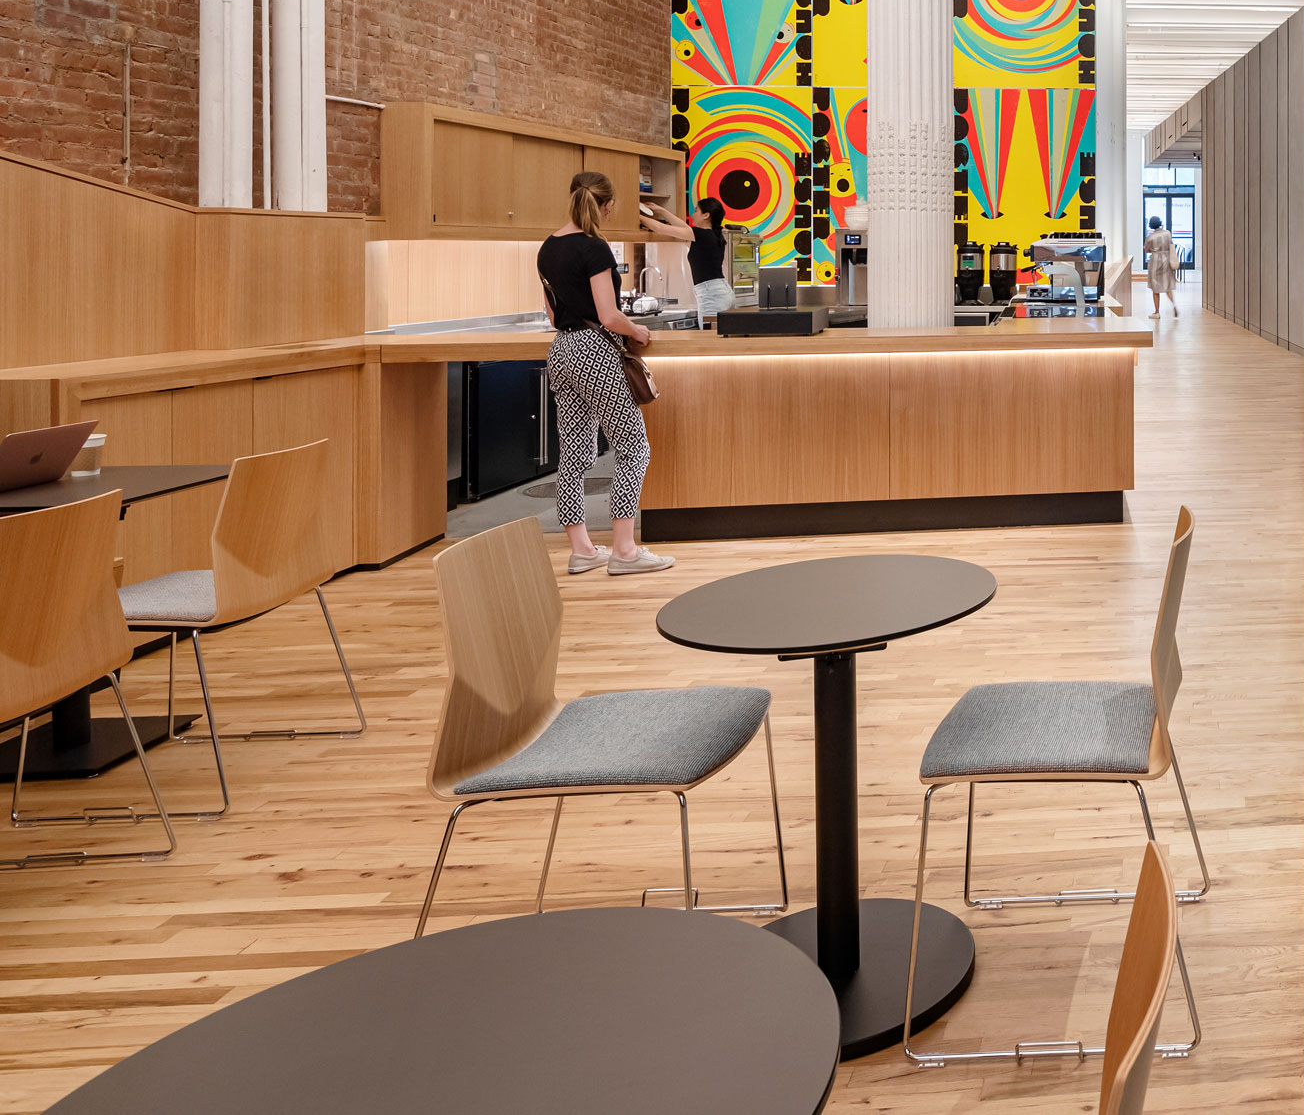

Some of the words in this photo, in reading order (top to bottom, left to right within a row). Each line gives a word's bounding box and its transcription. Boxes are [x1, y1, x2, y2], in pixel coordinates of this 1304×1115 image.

[794, 152, 812, 282] HOUSE
[812, 87, 831, 240] POSTER
[1079, 152, 1095, 230] USE
